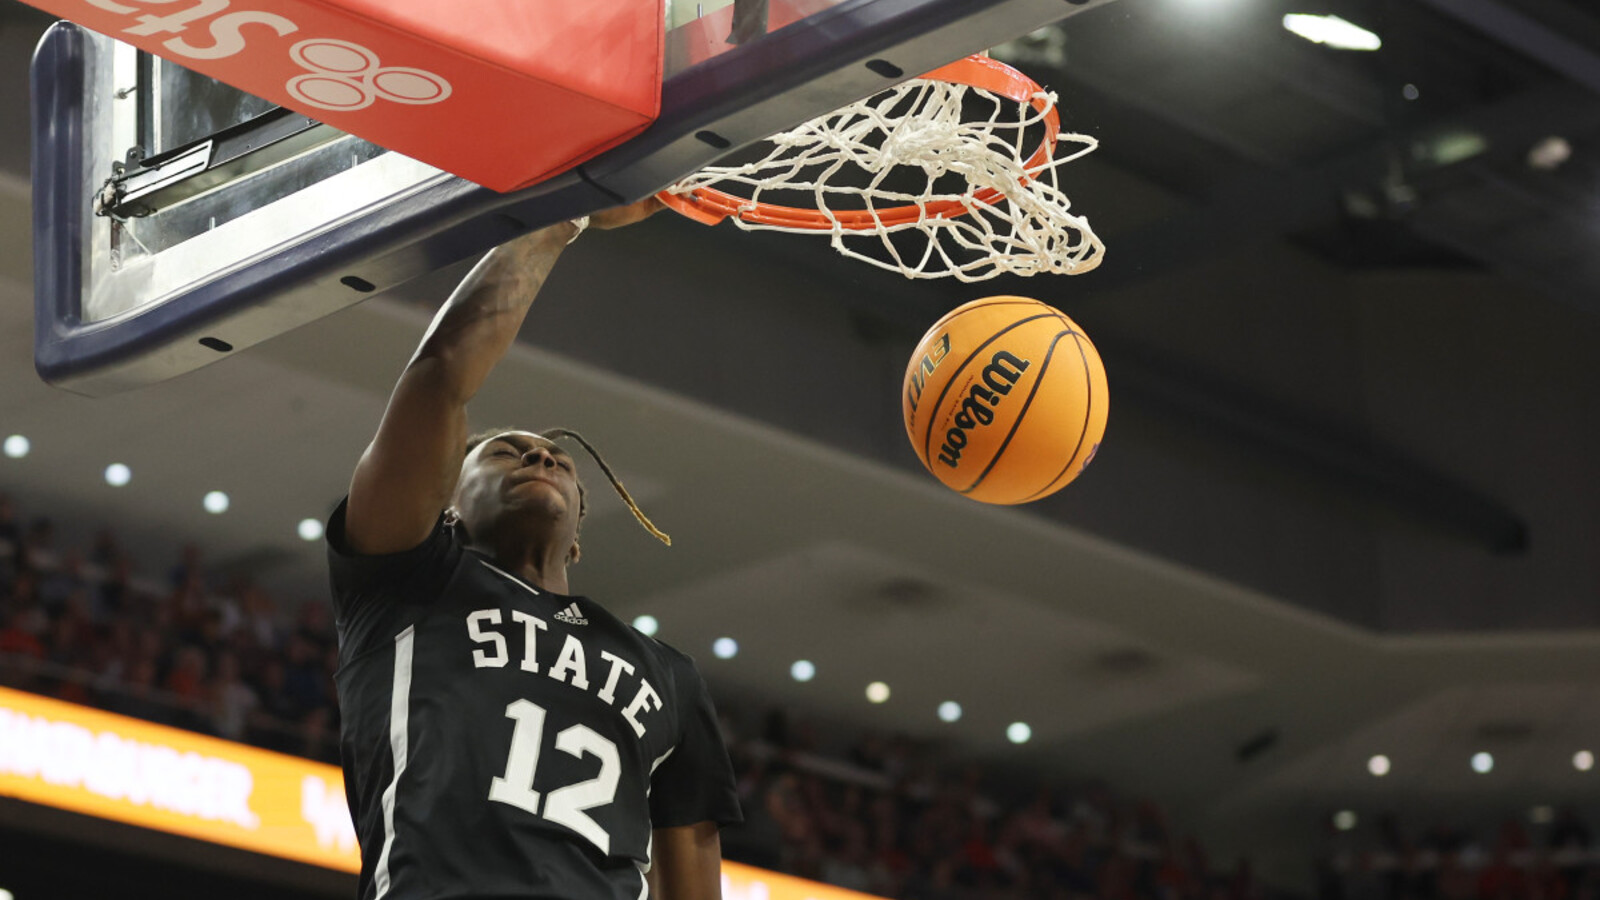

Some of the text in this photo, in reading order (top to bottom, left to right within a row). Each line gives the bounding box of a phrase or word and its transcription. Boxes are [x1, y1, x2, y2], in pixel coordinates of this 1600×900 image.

[86, 0, 299, 60] St
[938, 350, 1031, 469] Wilson
[466, 608, 663, 739] STATE
[553, 613, 589, 626] adidas
[487, 698, 622, 857] 12
